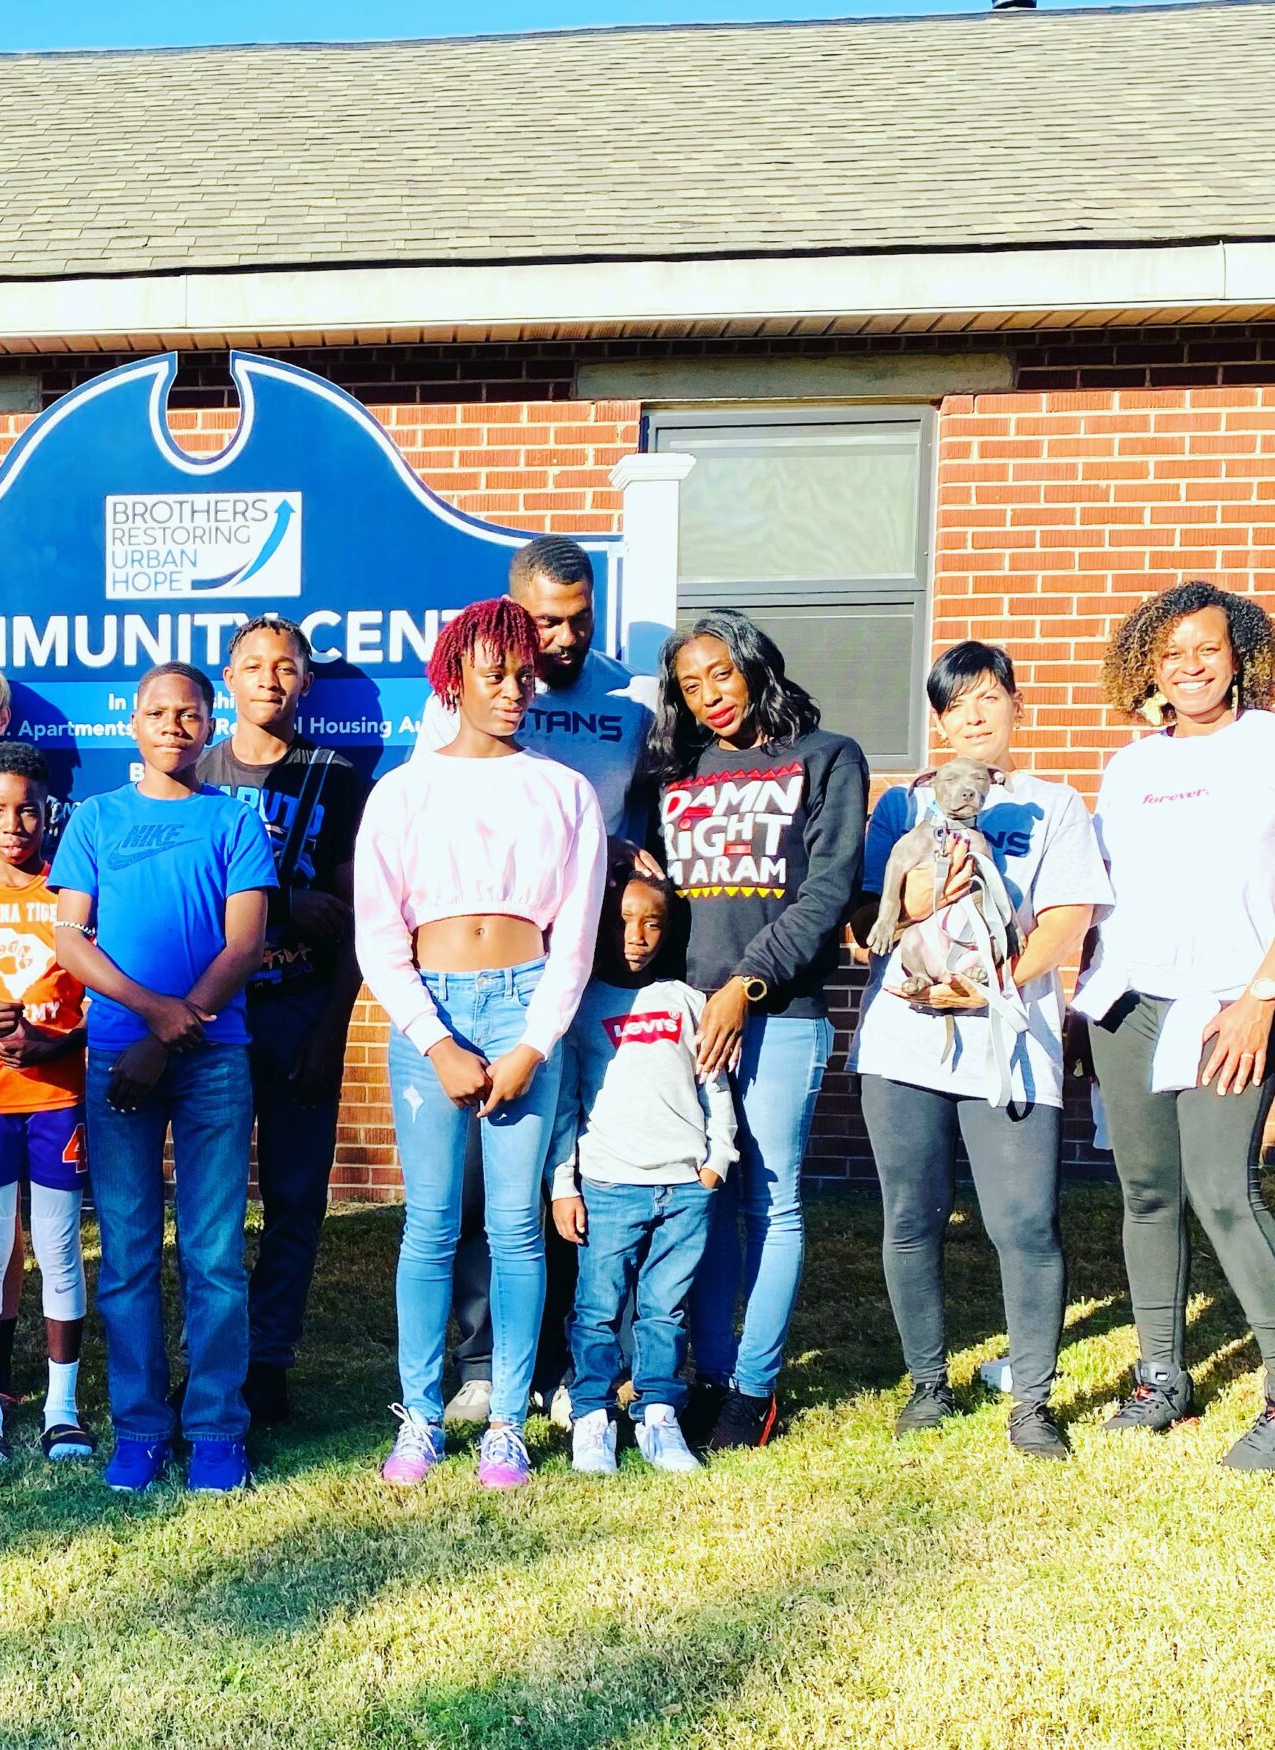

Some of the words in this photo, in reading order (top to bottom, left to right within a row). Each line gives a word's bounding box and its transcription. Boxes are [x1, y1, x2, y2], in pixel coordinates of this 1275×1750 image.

[112, 499, 268, 525] BROTHERS
[112, 525, 251, 546] RESTORING
[112, 548, 197, 569] URBAN
[112, 571, 183, 592] HOPE
[300, 609, 464, 664] CEN
[108, 693, 127, 710] In
[310, 716, 392, 738] Housing
[519, 707, 623, 743] TANS
[662, 775, 804, 825] DAMN
[1142, 788, 1210, 804] forever.
[121, 823, 186, 849] NIKE
[26, 902, 58, 922] TIGE
[62, 1122, 88, 1174] 4
